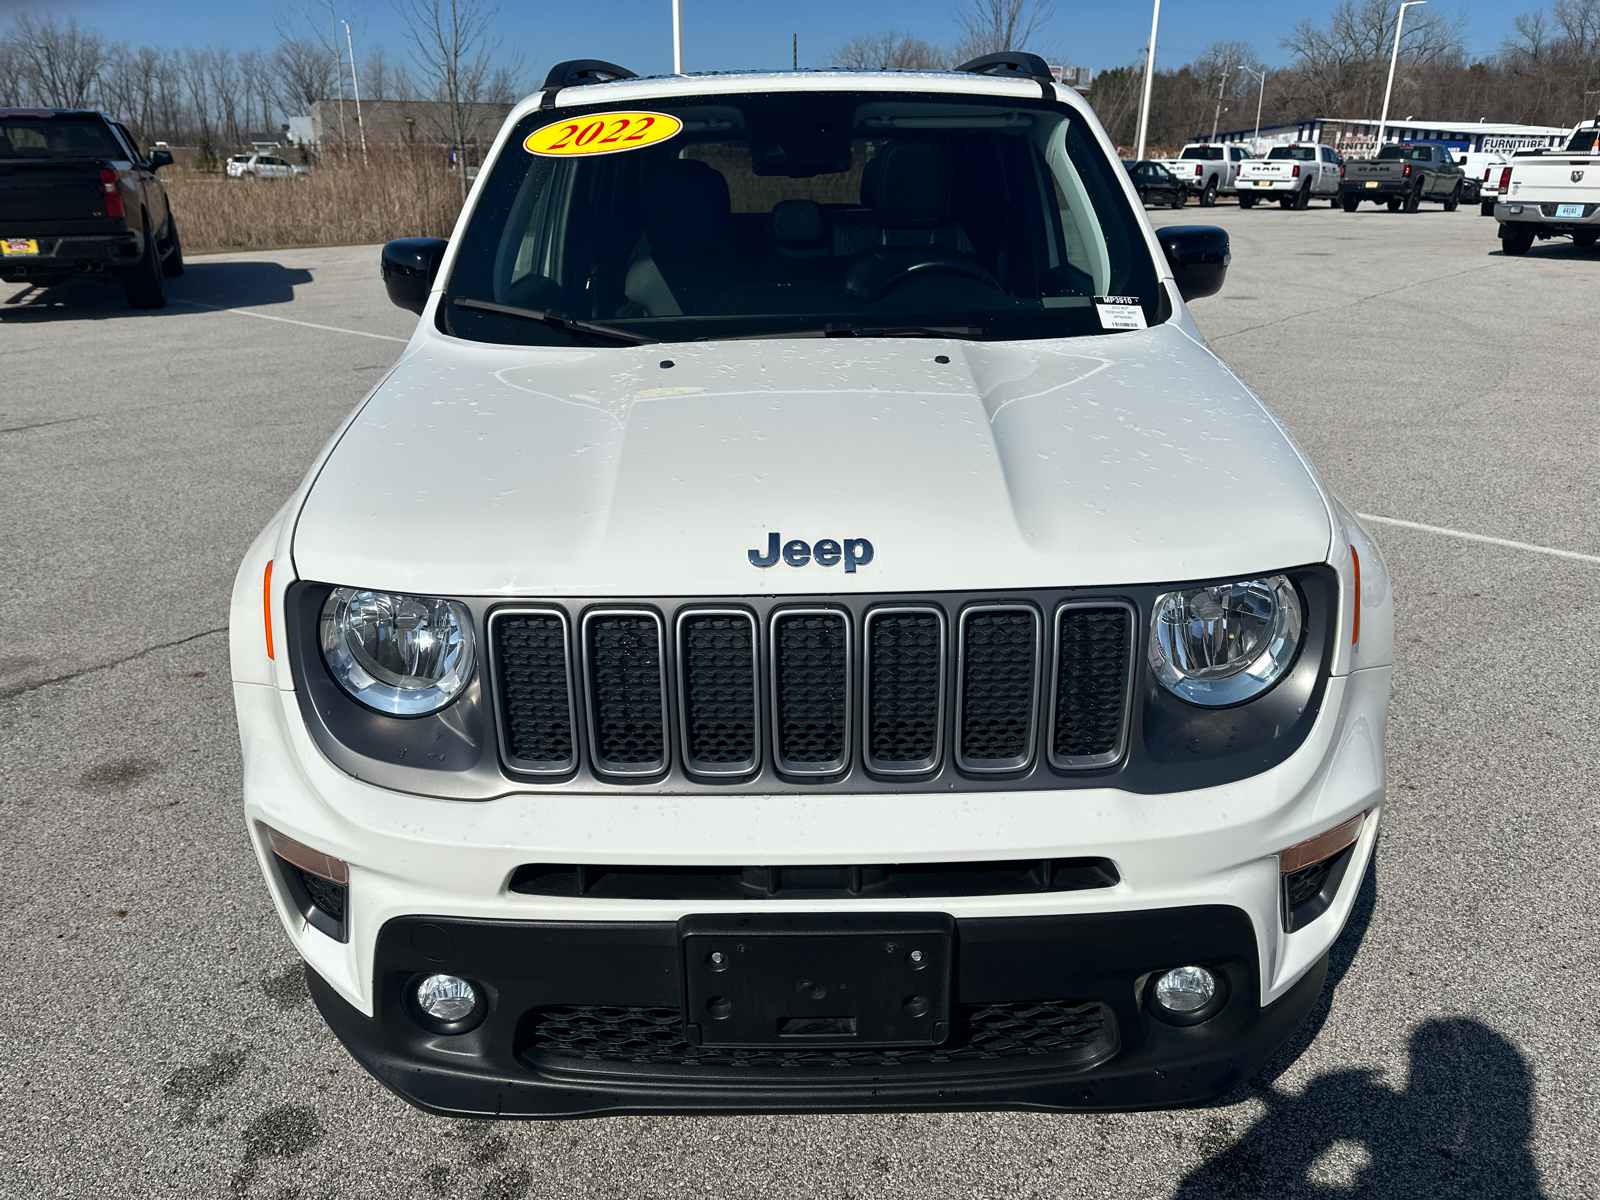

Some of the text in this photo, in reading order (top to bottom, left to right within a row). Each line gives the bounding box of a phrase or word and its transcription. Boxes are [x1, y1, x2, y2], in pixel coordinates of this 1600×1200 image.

[546, 117, 655, 151] 2022
[1484, 139, 1543, 148] FURNITURE
[747, 532, 875, 574] Jeep
